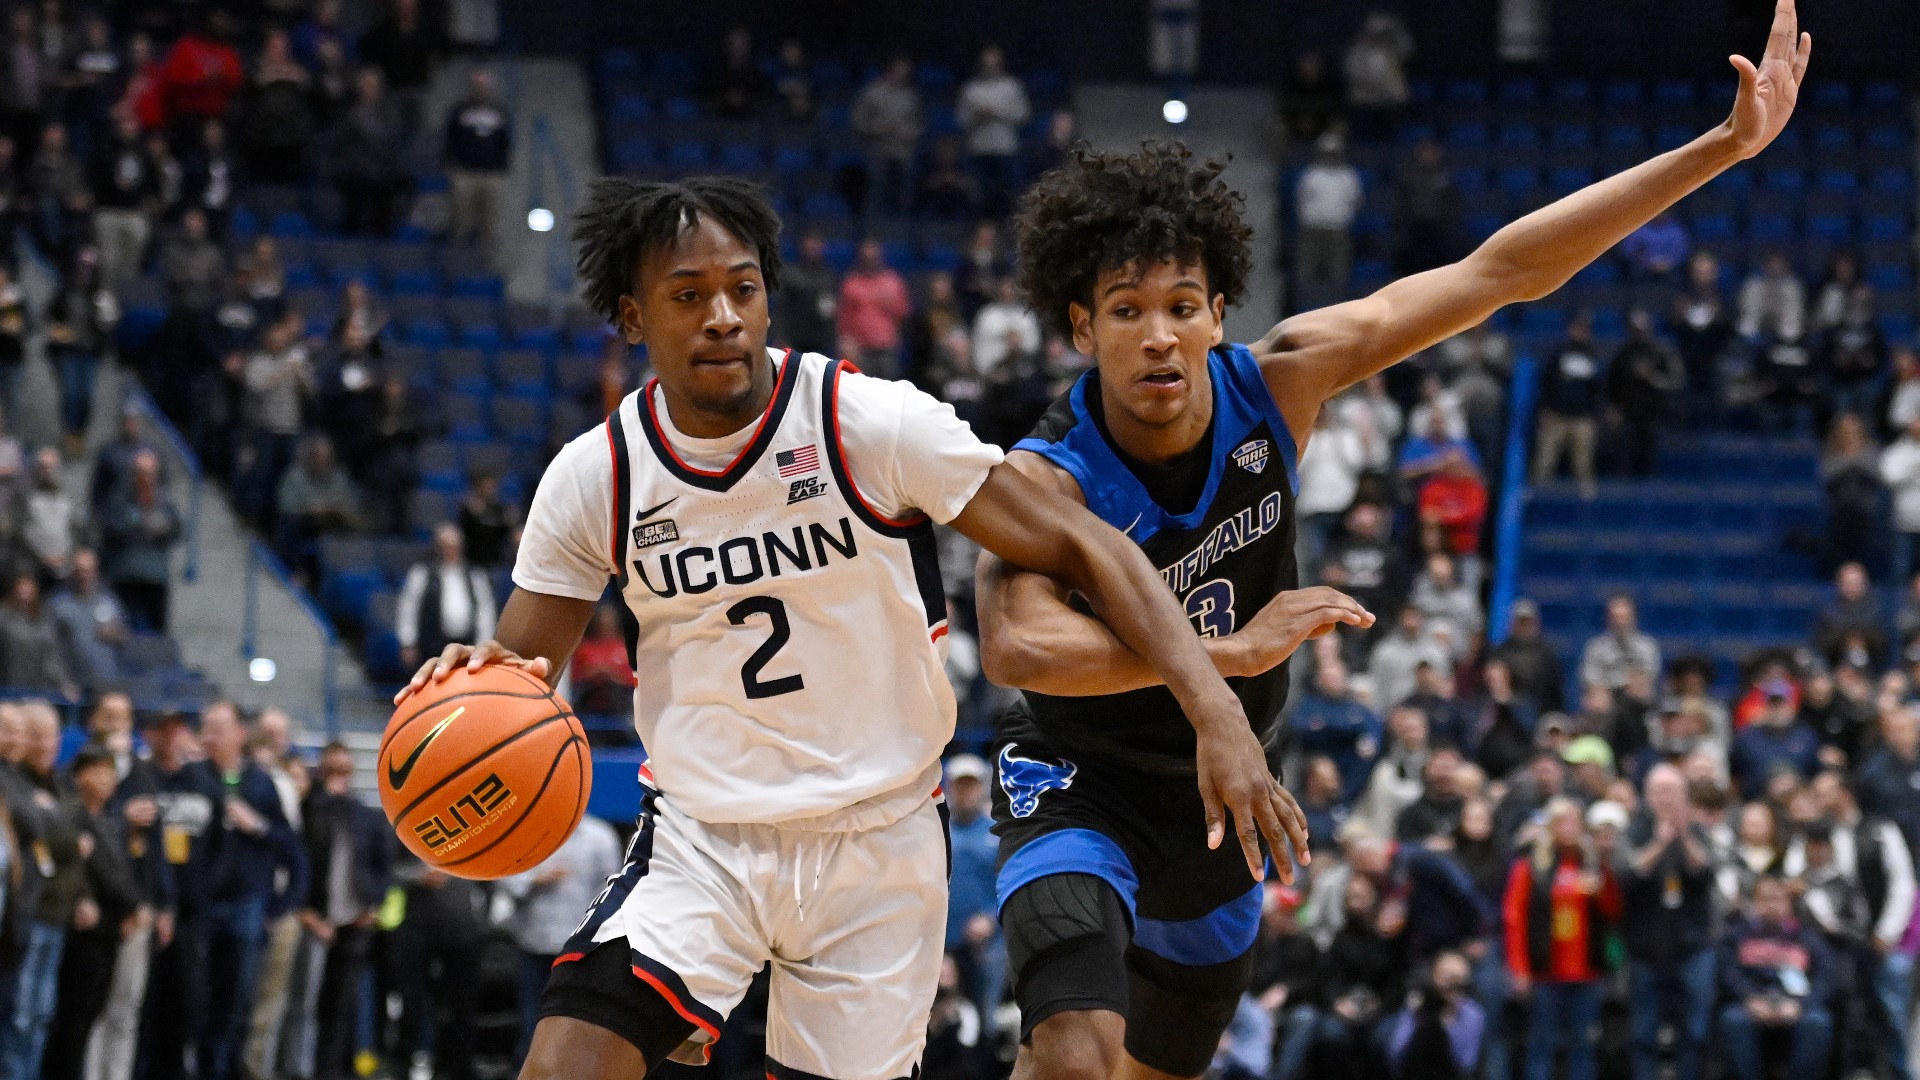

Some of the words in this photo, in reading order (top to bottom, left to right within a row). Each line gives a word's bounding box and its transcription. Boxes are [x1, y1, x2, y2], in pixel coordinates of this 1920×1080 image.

[790, 476, 818, 491] BIG
[1236, 446, 1269, 467] MAC
[788, 483, 827, 500] EAST
[633, 517, 858, 599] UCONN
[637, 531, 677, 547] CHANGE
[1159, 491, 1281, 593] FFALO
[1183, 578, 1235, 639] 3
[725, 595, 805, 700] 2
[413, 771, 512, 849] ELITE
[434, 795, 518, 857] CHAMPIONSHIP
